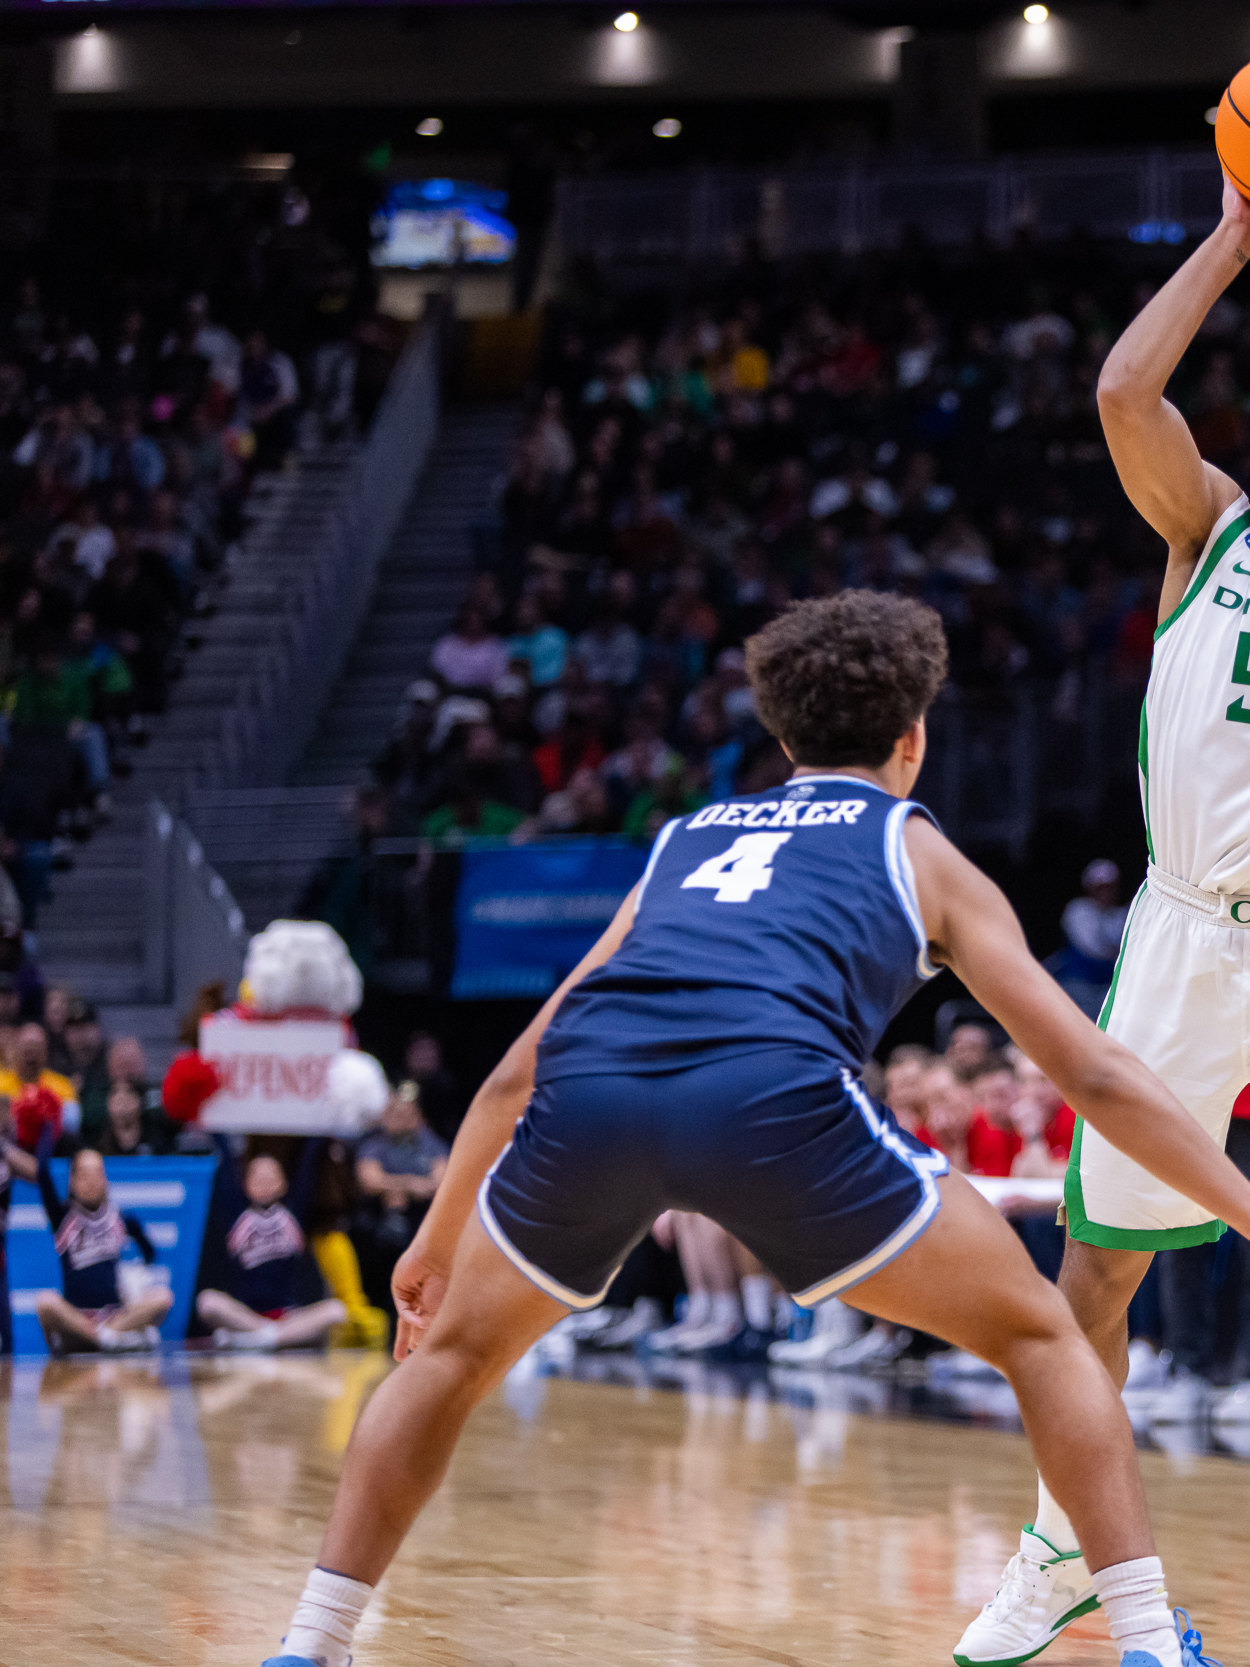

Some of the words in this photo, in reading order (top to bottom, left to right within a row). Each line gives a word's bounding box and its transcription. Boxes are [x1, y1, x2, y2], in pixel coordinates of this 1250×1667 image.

[685, 799, 868, 830] DECKER
[680, 831, 793, 903] 4
[207, 1053, 334, 1102] EFENS
